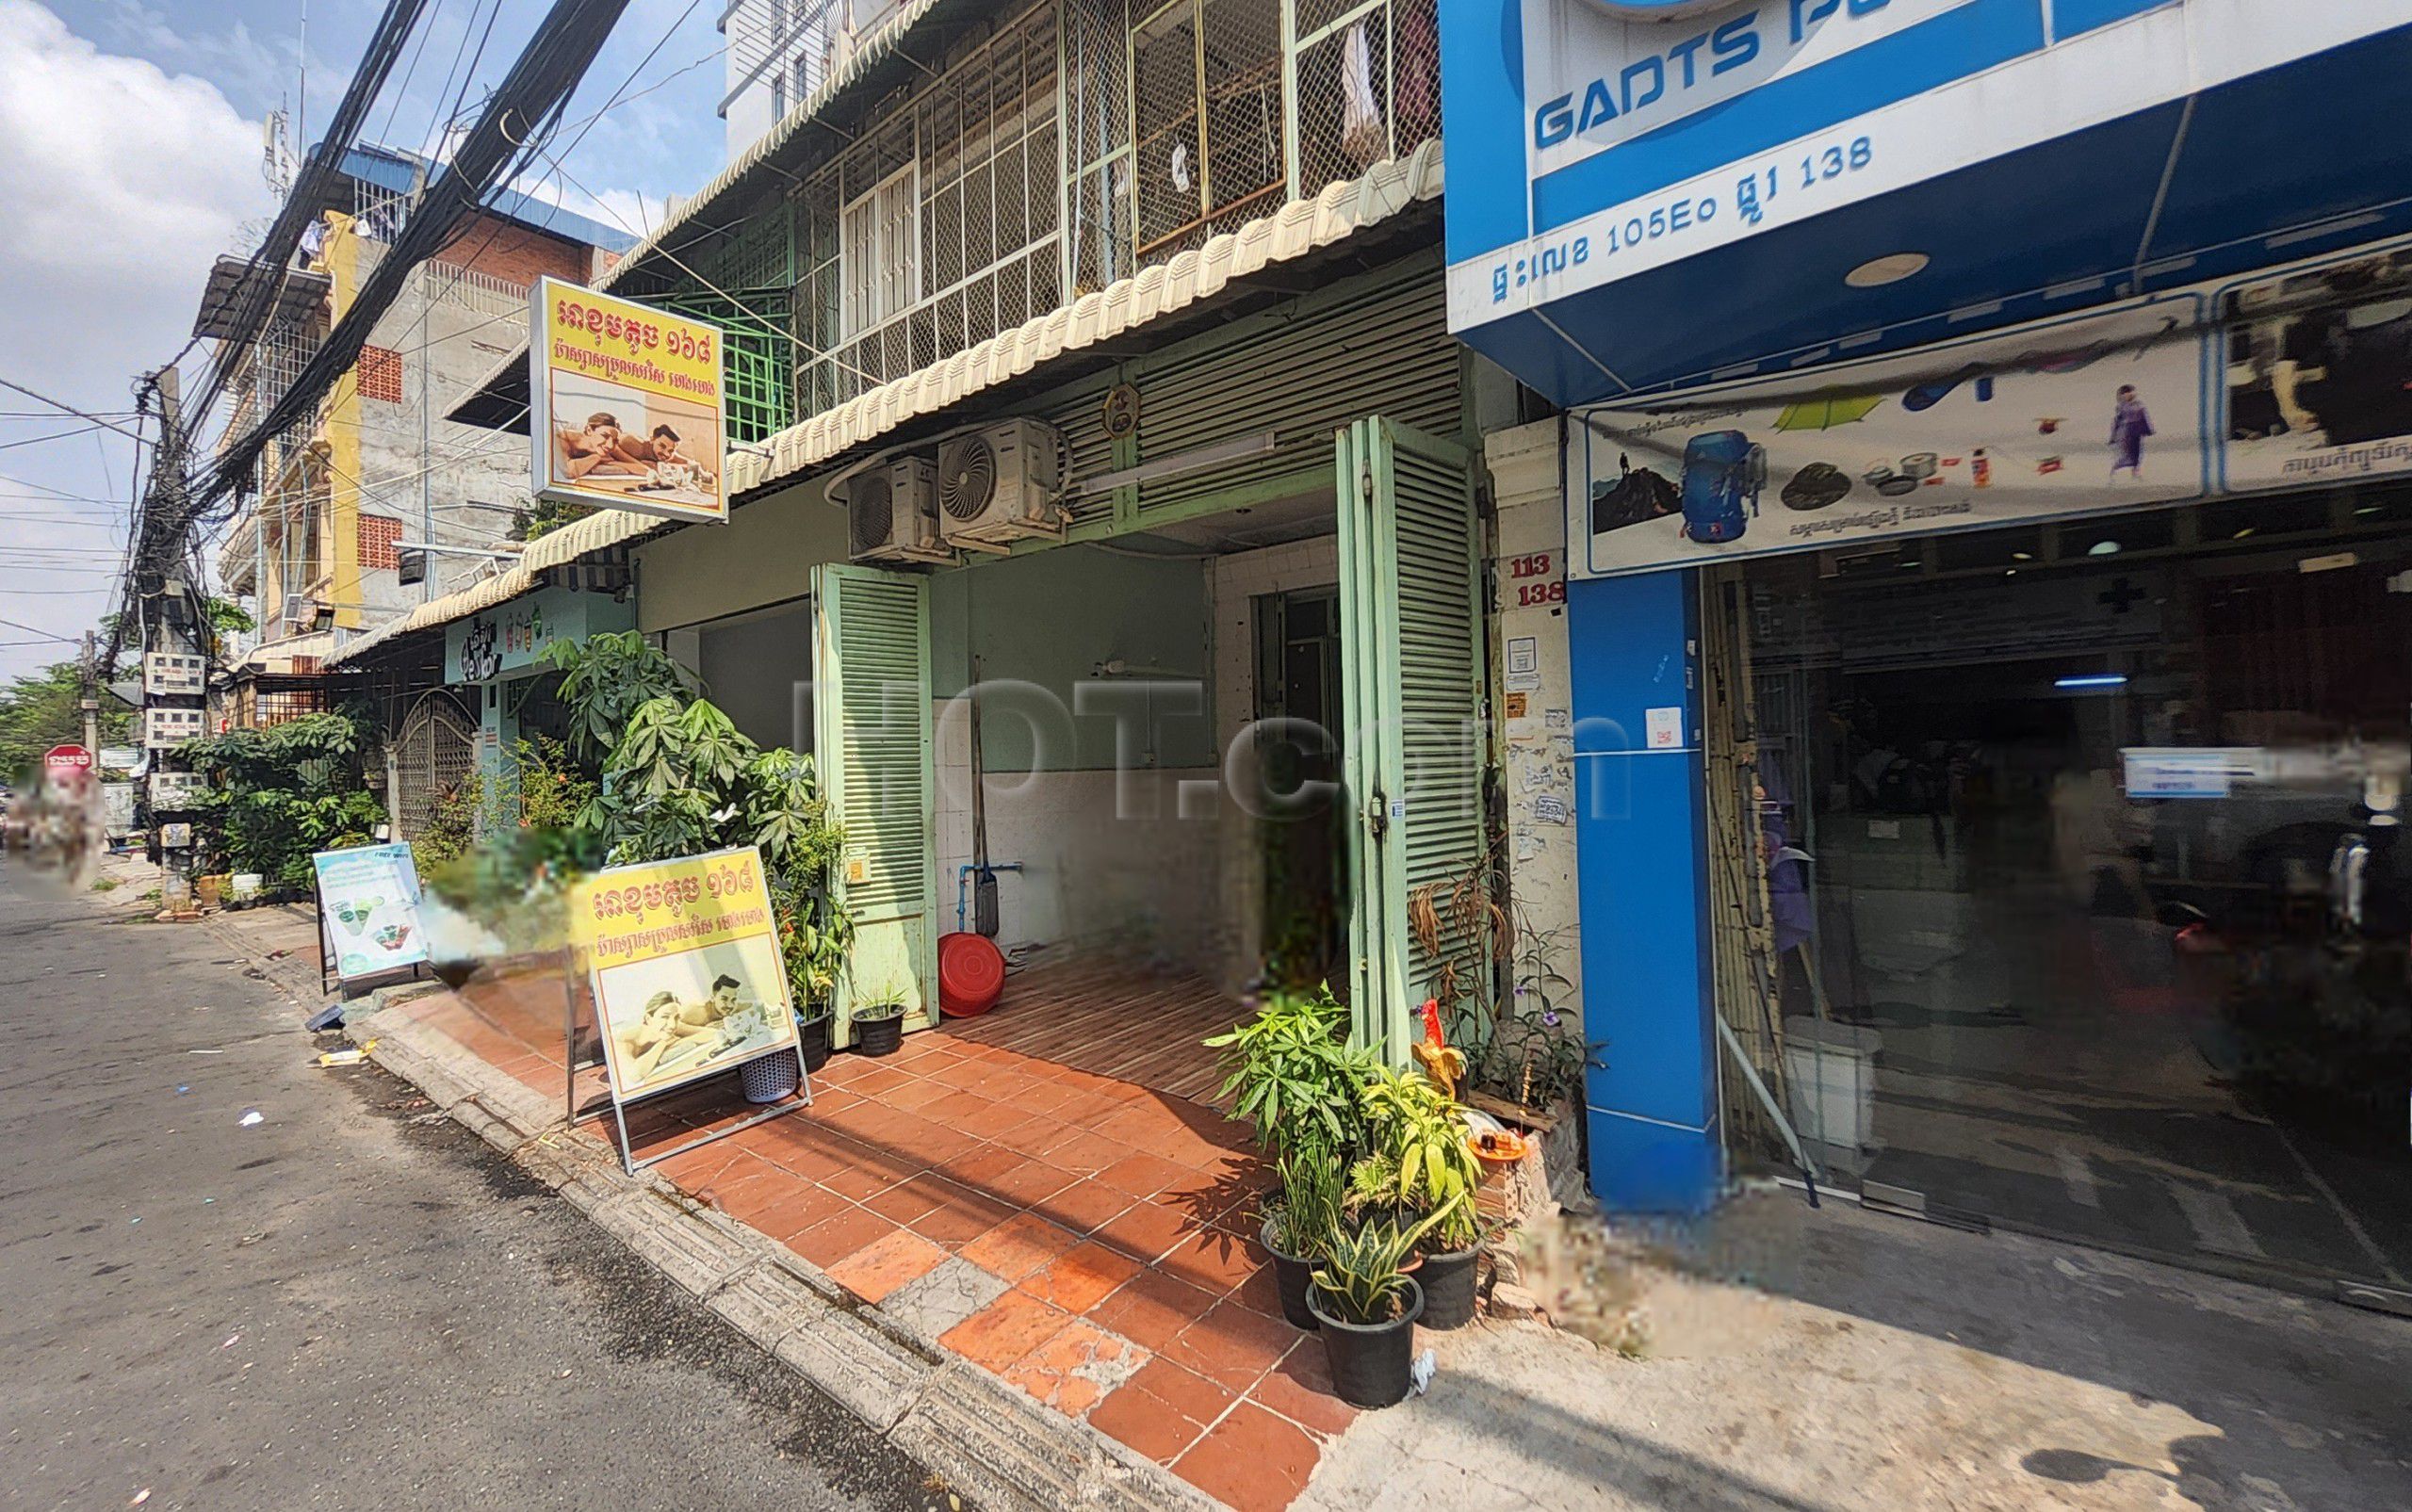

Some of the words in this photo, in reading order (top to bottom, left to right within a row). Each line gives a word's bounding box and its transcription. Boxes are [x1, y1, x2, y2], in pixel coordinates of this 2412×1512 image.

[1535, 9, 1760, 149] GADTS
[1493, 236, 1589, 304] ផ្ទះលេខ
[1801, 136, 1872, 188] 138
[665, 326, 711, 365] ១៦៨
[1511, 554, 1551, 578] 113
[1518, 580, 1564, 607] 138
[706, 860, 755, 899] ១៦៨
